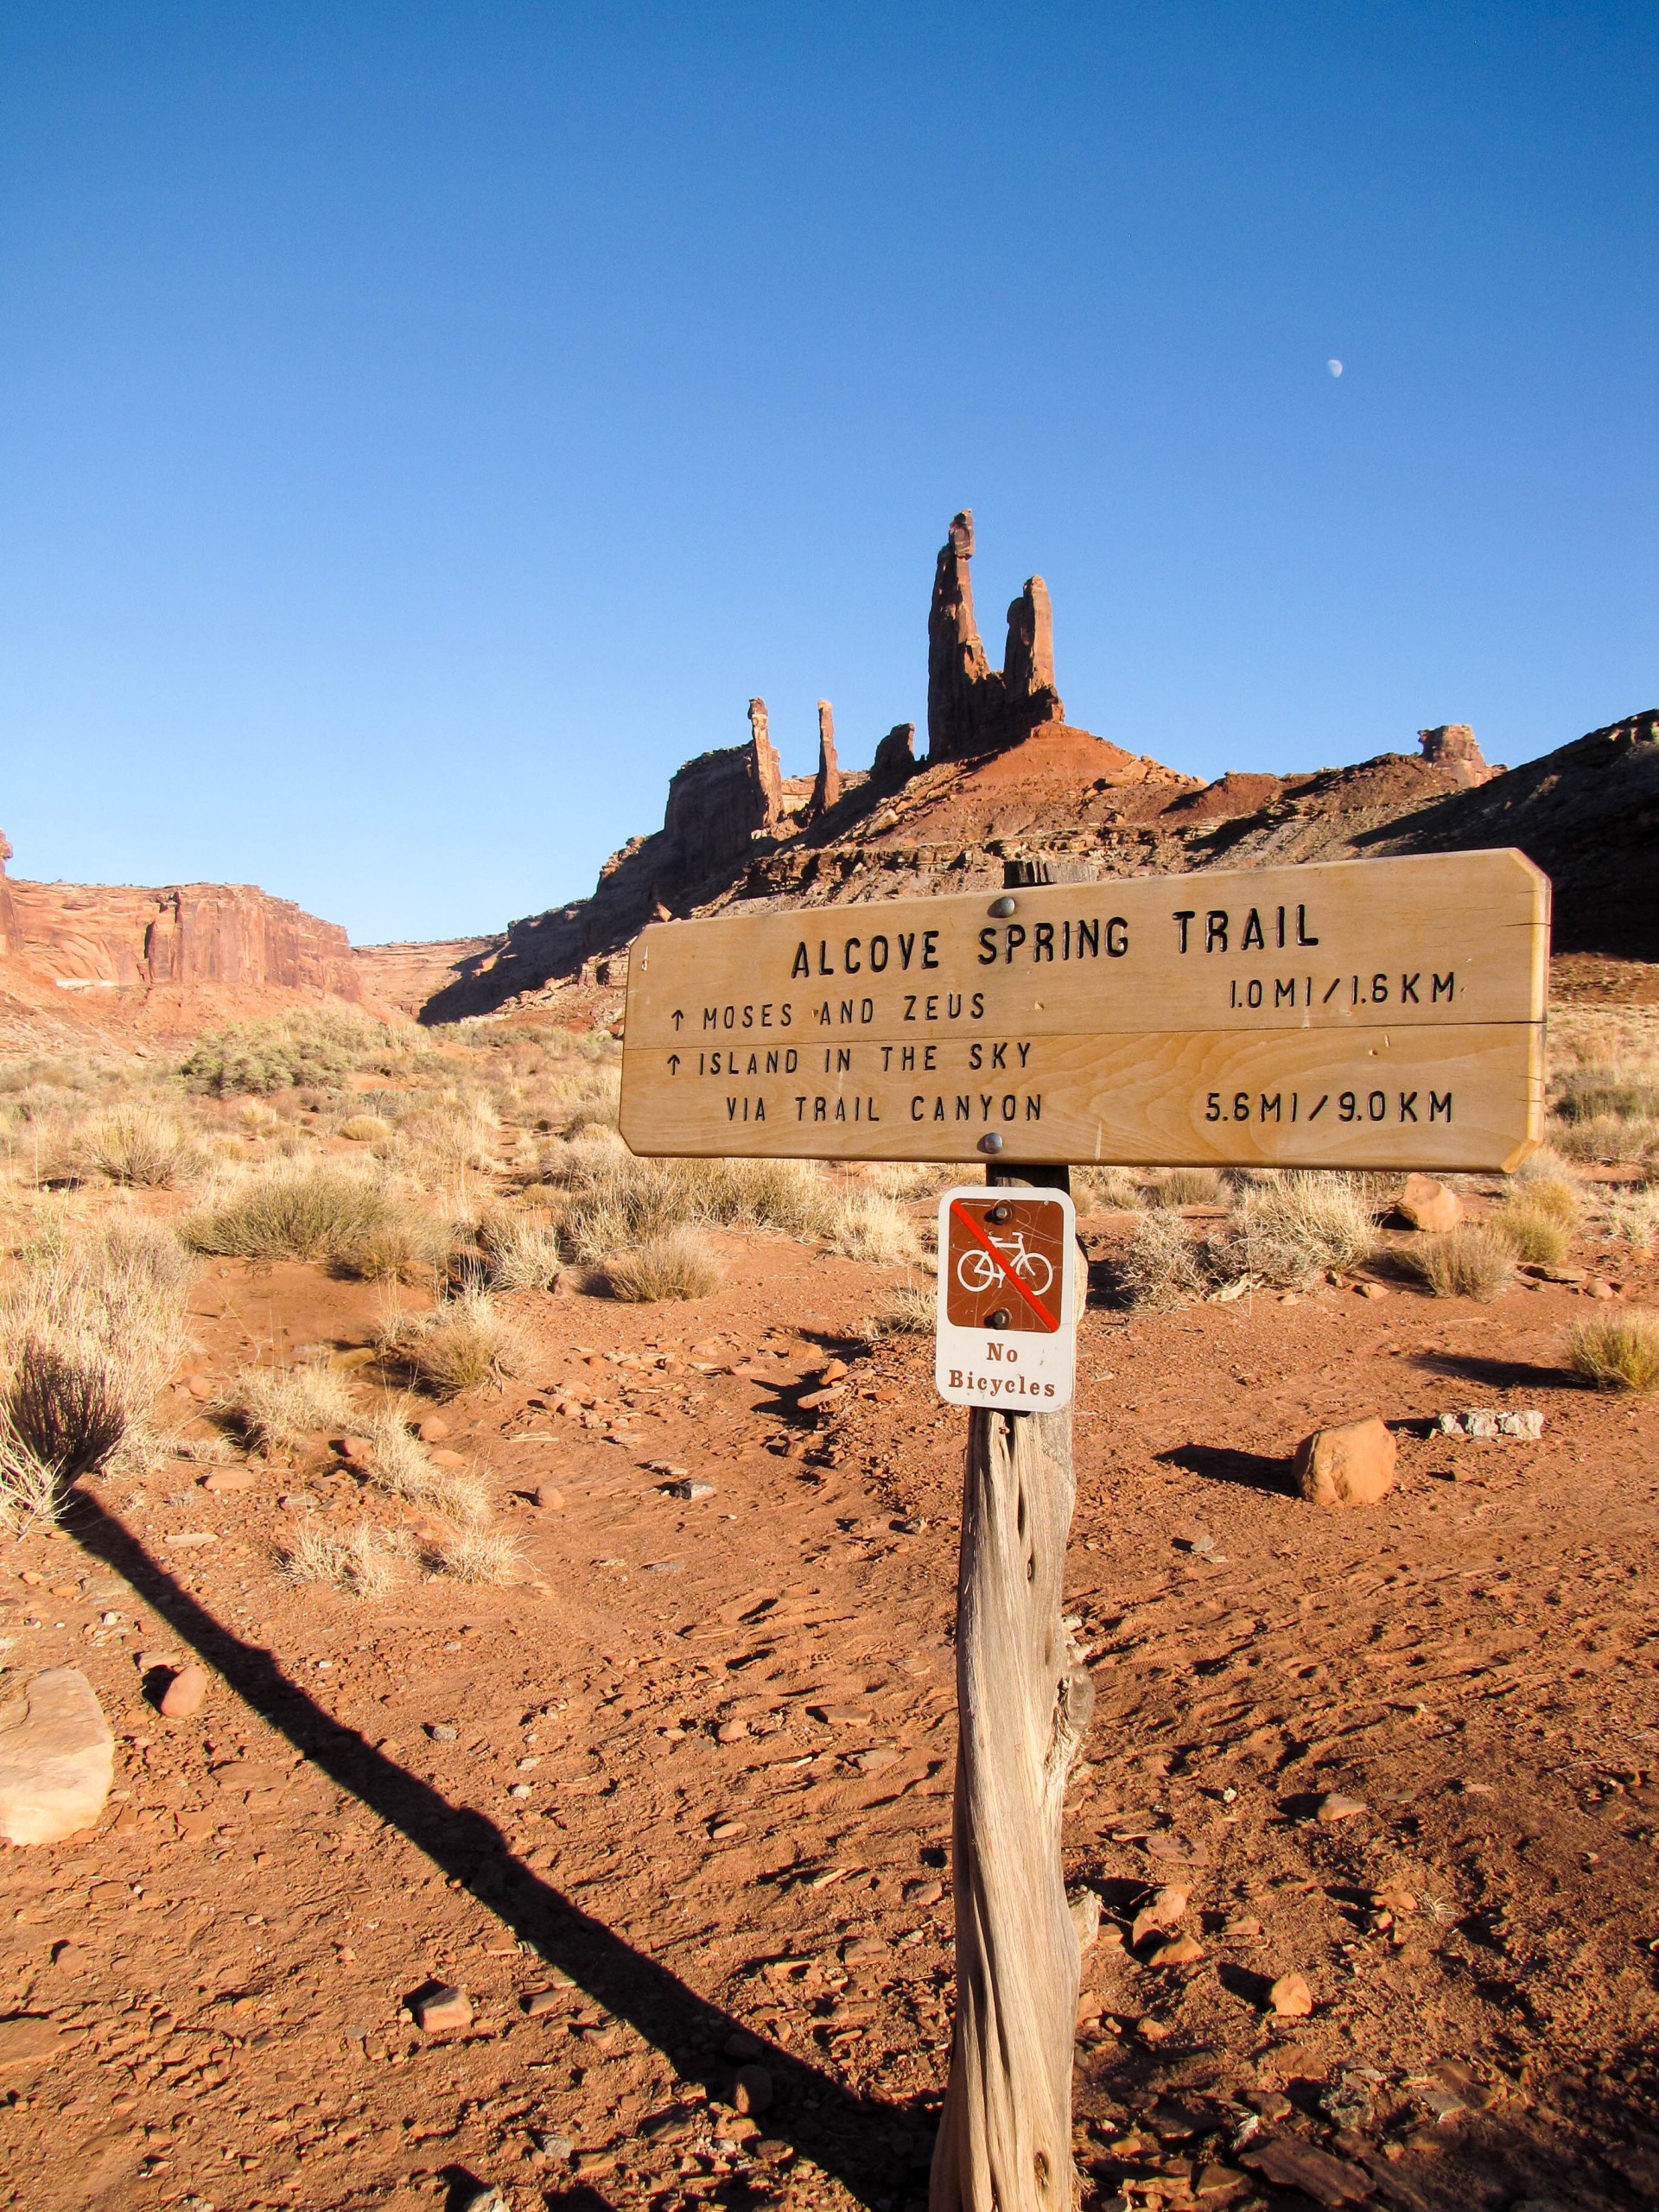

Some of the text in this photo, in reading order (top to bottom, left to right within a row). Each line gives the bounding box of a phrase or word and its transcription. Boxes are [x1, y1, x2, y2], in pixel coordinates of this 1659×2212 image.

[791, 904, 1319, 978] ALCOVE SPRING TRAIL
[703, 1003, 792, 1030] MOSES
[819, 998, 874, 1026] AND
[904, 993, 985, 1021] ZEUS
[699, 1042, 1032, 1076] ISLAND IN THE SKY
[726, 1096, 766, 1122] VIA
[795, 1096, 880, 1122] TRAIL
[911, 1094, 1042, 1122] CANYON
[986, 1342, 1019, 1363] No
[948, 1370, 1056, 1397] Bicycles
